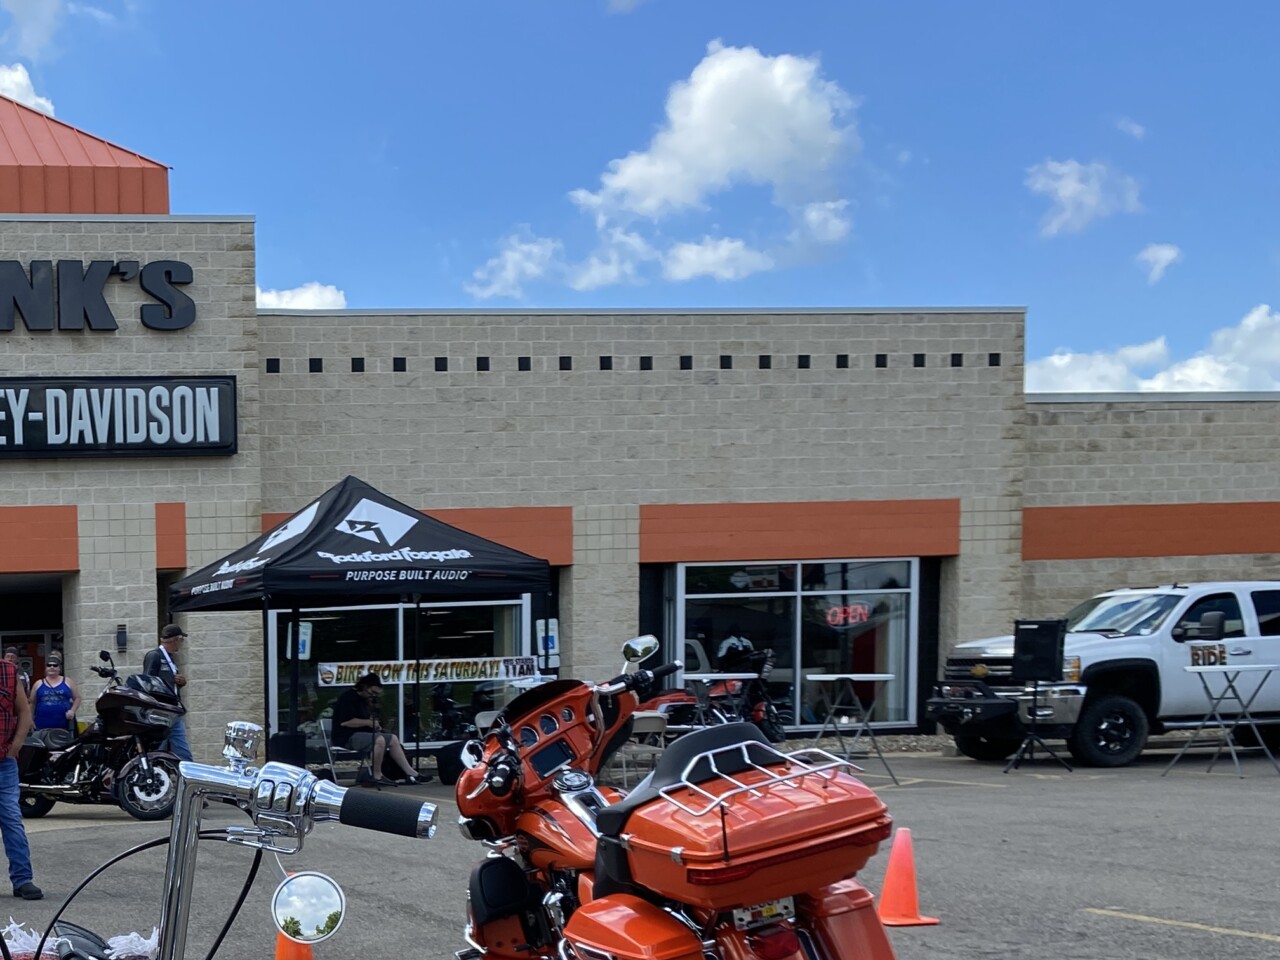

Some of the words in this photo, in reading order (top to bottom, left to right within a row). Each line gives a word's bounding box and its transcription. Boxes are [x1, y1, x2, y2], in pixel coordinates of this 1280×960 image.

[316, 549, 404, 565] Rockford
[345, 570, 398, 581] PURPOSE
[398, 570, 433, 580] BUILT
[432, 570, 469, 580] AUDIO
[826, 604, 869, 626] OPEN
[1191, 650, 1228, 667] RIDE
[335, 663, 365, 684] BIKE
[433, 659, 500, 680] SATURDAY!
[504, 664, 535, 678] 11AM
